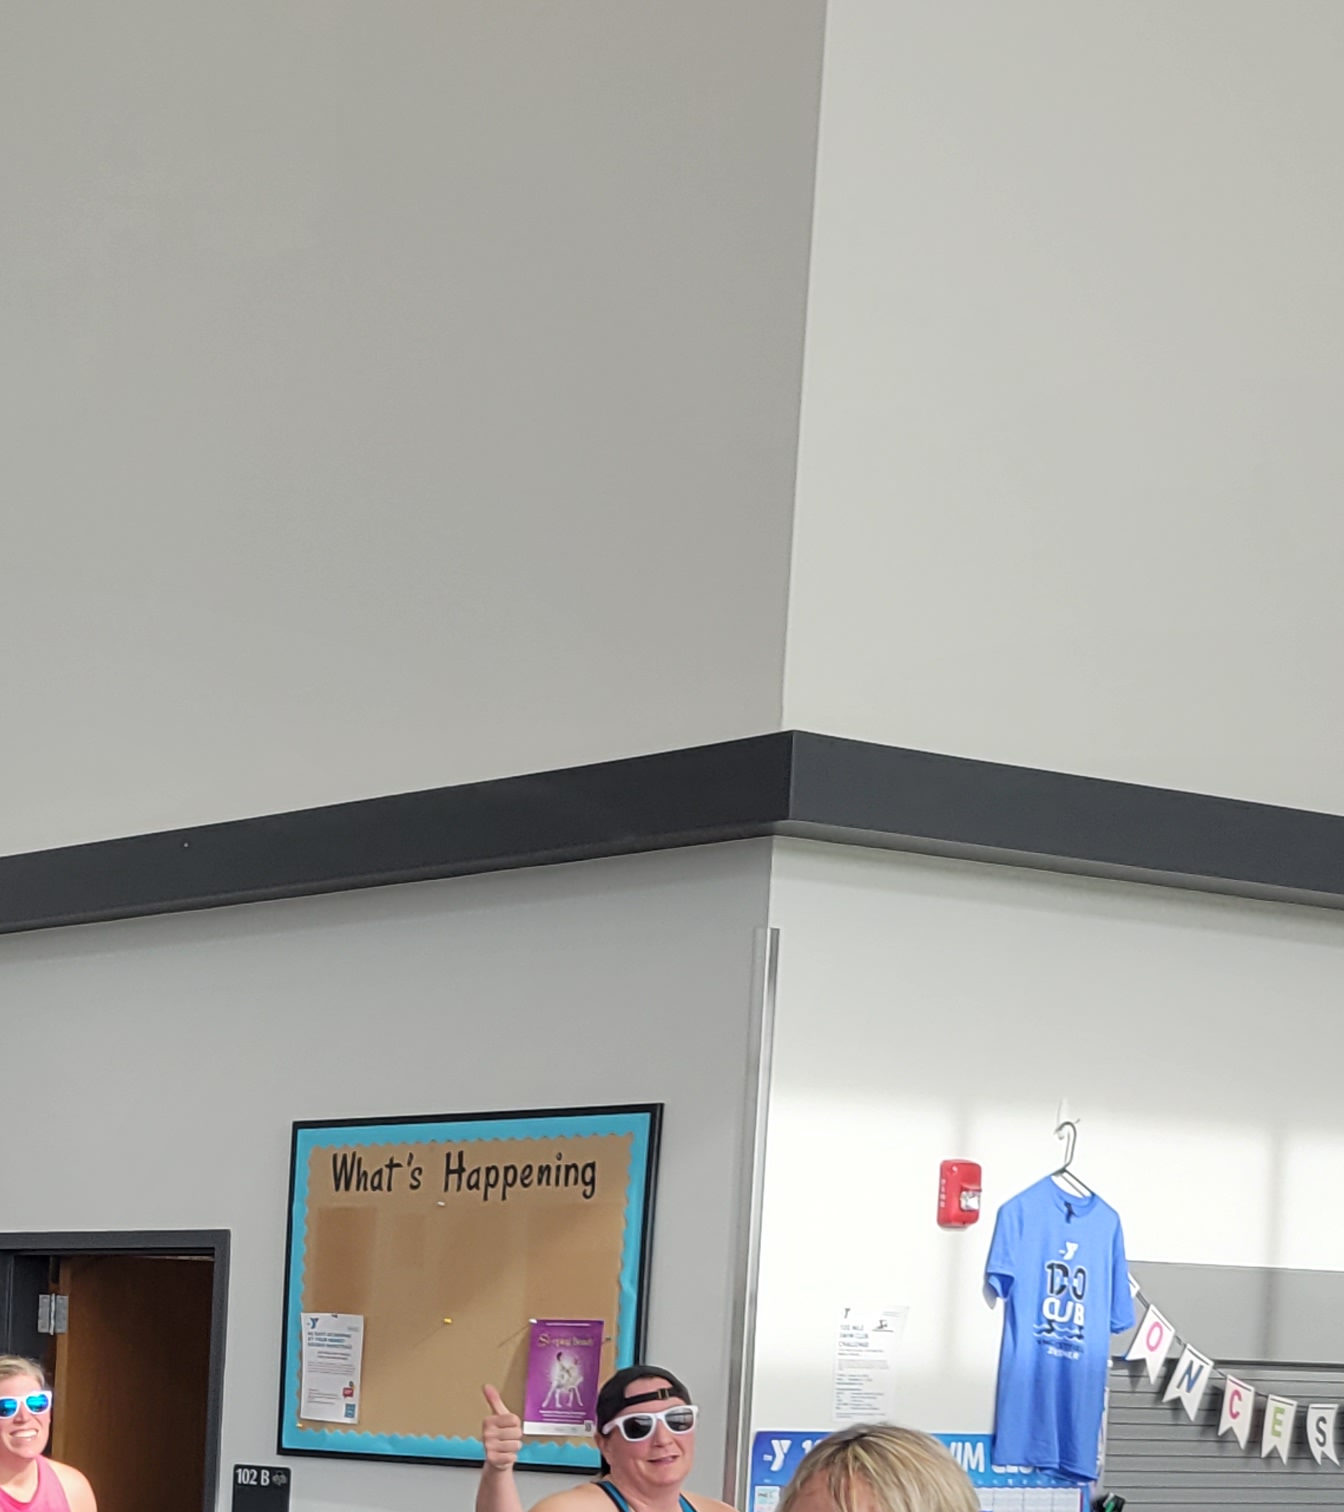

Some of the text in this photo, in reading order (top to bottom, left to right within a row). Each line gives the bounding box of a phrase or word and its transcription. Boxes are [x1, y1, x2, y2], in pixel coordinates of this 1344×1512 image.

[331, 1151, 597, 1200] What's Happening
[235, 1468, 270, 1486] 102 B
